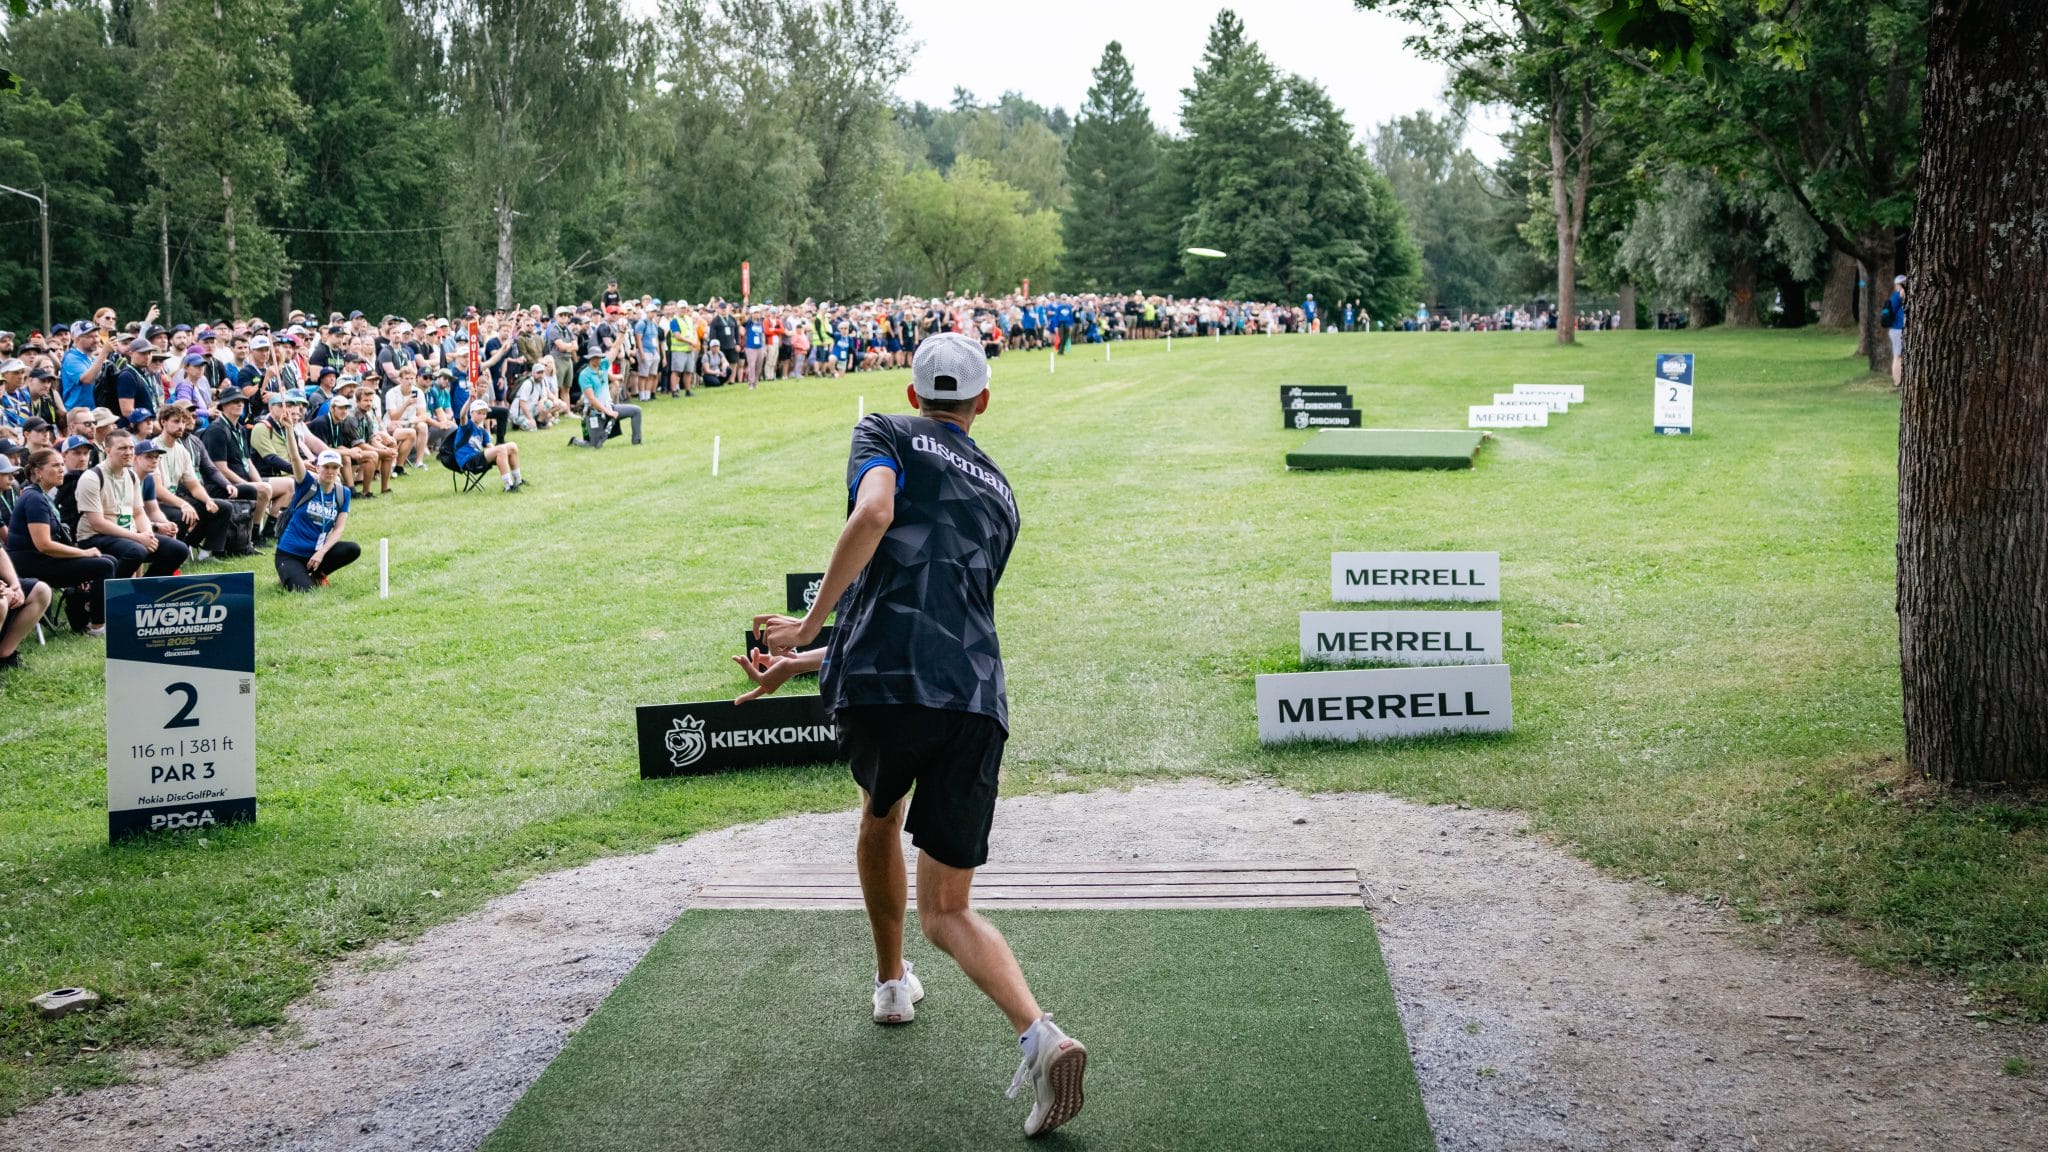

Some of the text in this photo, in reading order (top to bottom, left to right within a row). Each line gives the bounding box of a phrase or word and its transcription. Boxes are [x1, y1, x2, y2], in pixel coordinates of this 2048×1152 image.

[1669, 387, 1678, 402] 2
[1475, 412, 1538, 422] MERRELL
[912, 434, 1017, 522] discman
[1345, 568, 1486, 586] MERRELL
[135, 605, 228, 628] WORLD
[136, 623, 223, 637] CHAMPIONSHIPS
[166, 636, 197, 646] 2025
[1317, 631, 1486, 652] MERRELL
[163, 681, 200, 729] 2
[1278, 691, 1490, 724] MERRELL
[131, 743, 155, 759] 116
[161, 745, 174, 757] m
[190, 738, 216, 754] 381
[223, 736, 234, 751] ft
[711, 725, 838, 749] KIEKKOKIN
[151, 762, 215, 784] PAR 3
[138, 793, 164, 805] Nokia
[150, 809, 215, 830] PDGA
